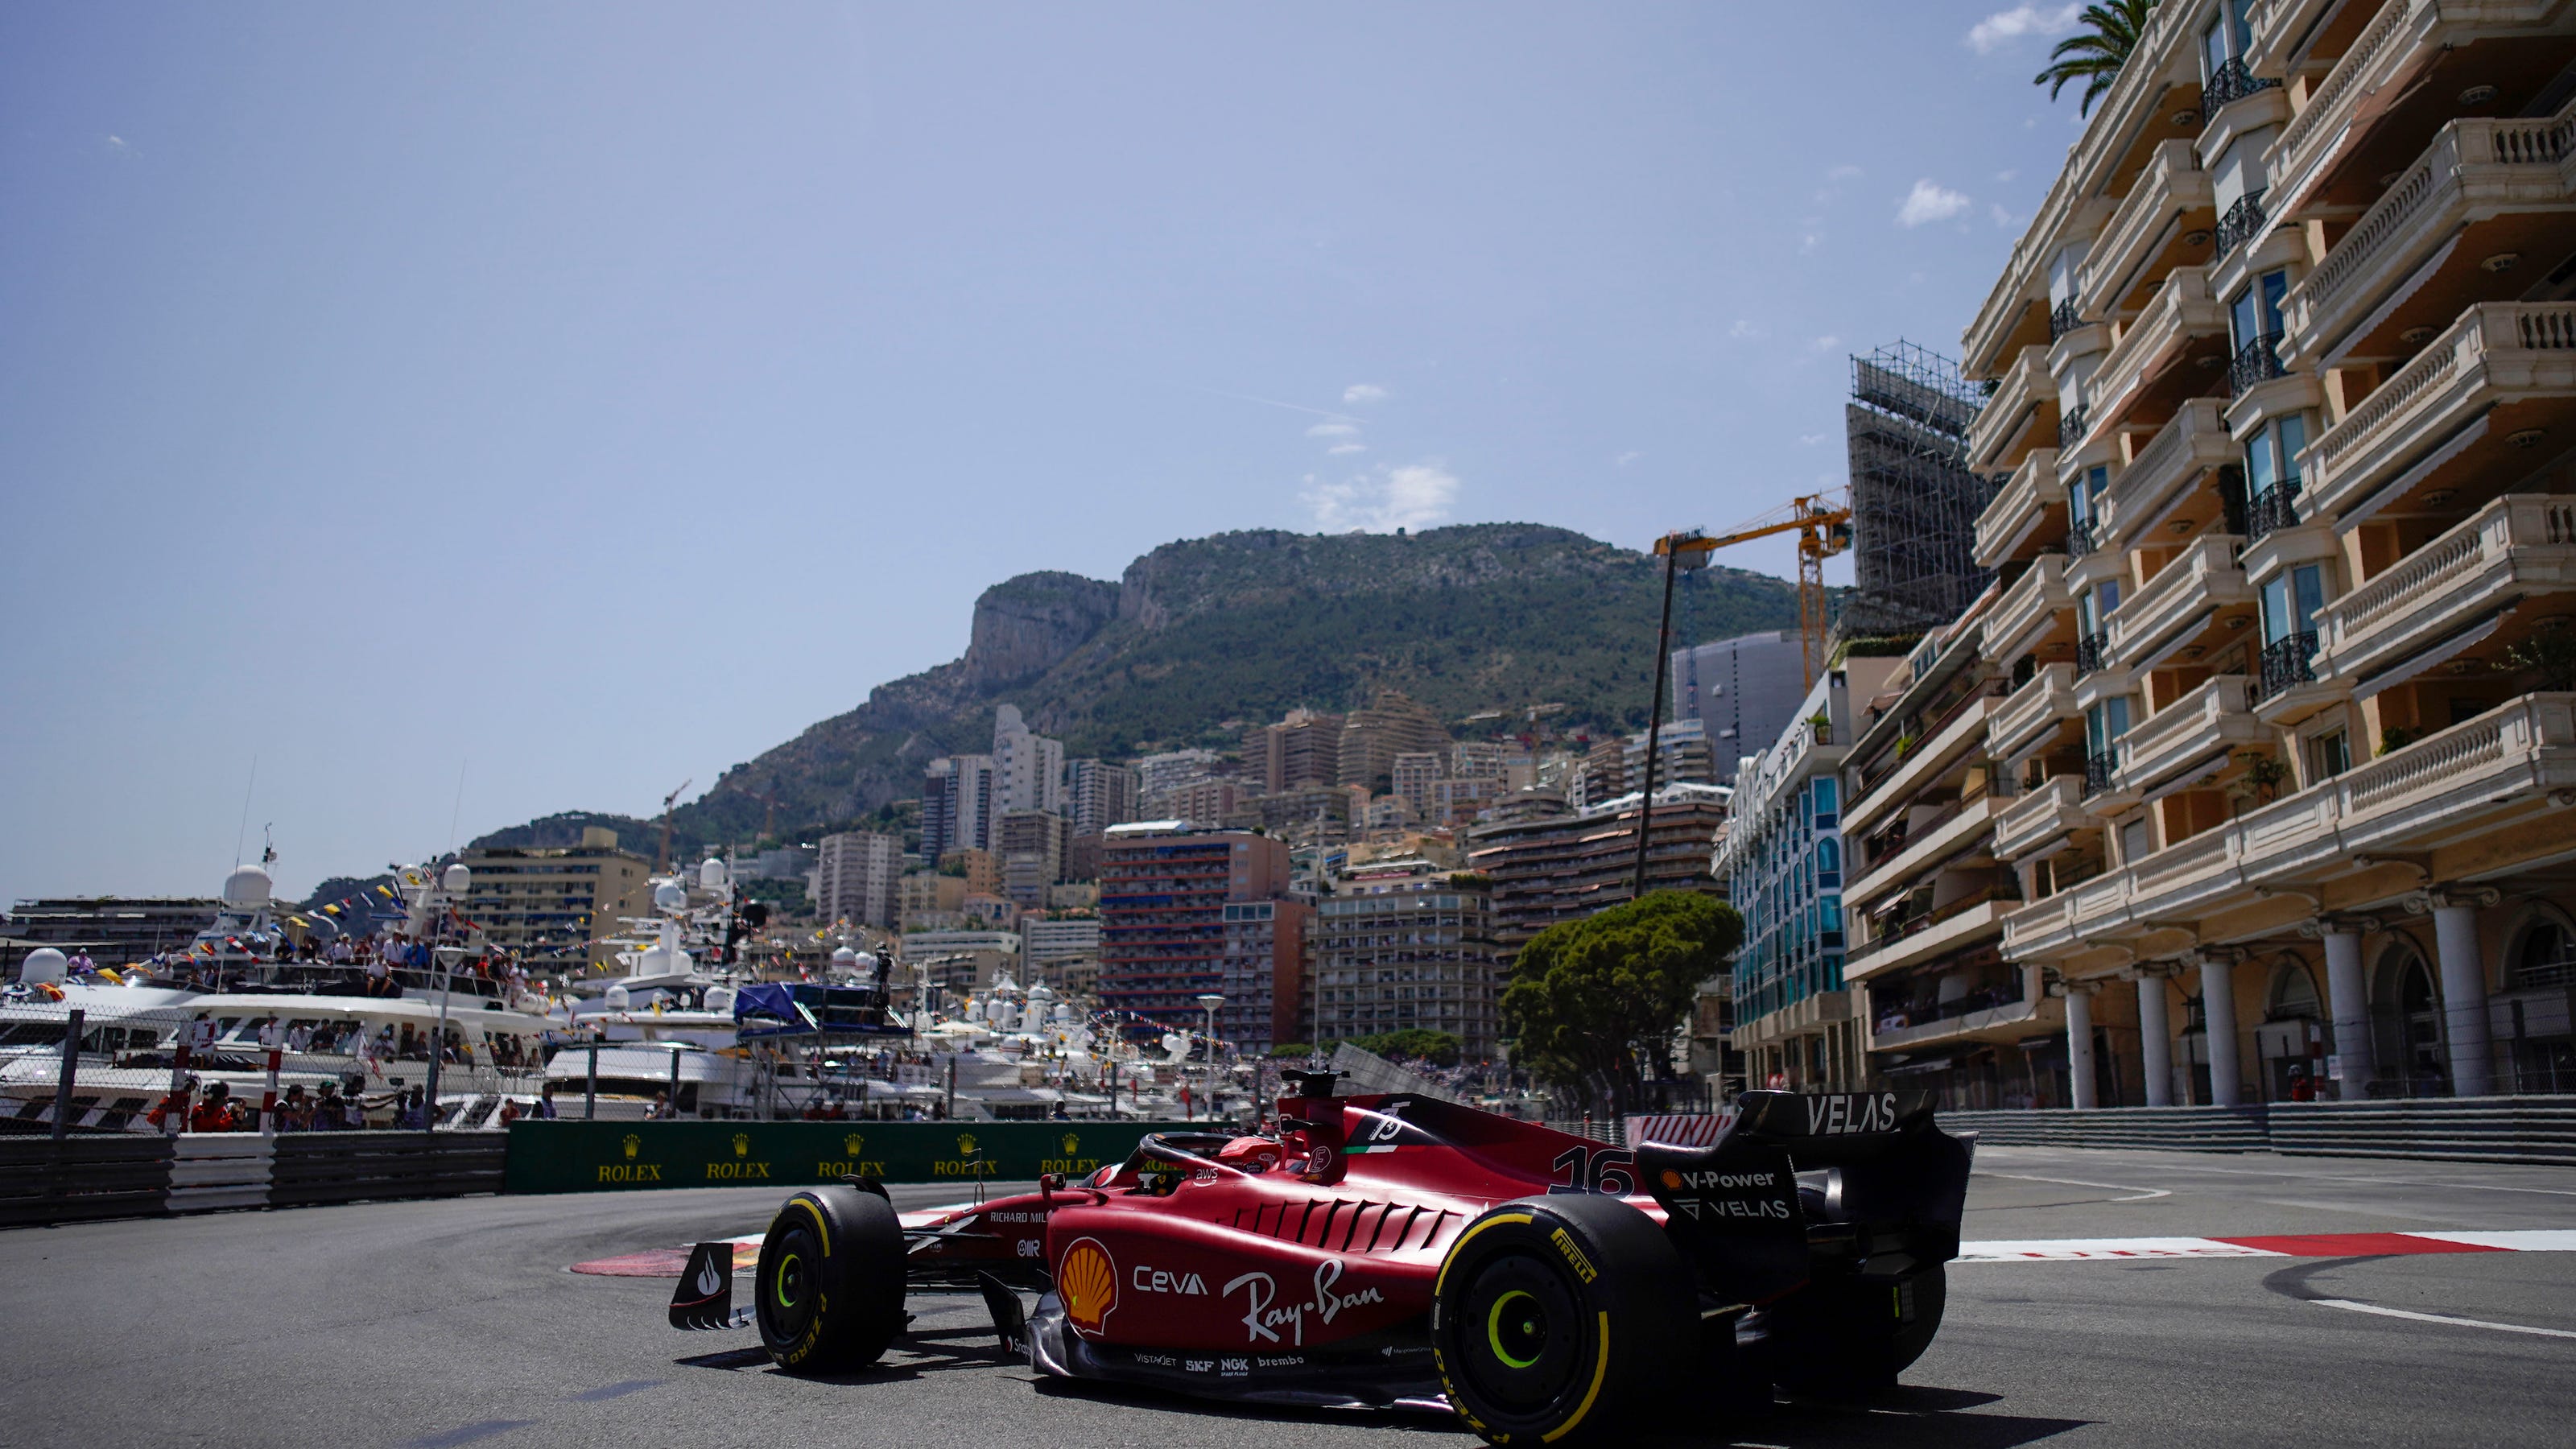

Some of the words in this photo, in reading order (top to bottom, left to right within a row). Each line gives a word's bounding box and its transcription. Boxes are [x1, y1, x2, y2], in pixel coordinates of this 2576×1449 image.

[1806, 1092, 1897, 1136] VELAS
[598, 1165, 662, 1183] ROLEX
[706, 1162, 770, 1179] ROLEX
[817, 1162, 886, 1178] ROLEX
[934, 1160, 997, 1175] ROLEX
[1040, 1159, 1100, 1174] ROLEX
[1196, 1167, 1219, 1180] aws
[1547, 1146, 1634, 1199] 16
[1682, 1171, 1774, 1190] V-Power
[990, 1212, 1028, 1223] RICHARD
[1030, 1212, 1047, 1223] MIL
[1708, 1199, 1790, 1220] VELAS
[1550, 1227, 1598, 1285] PIRELLI
[1014, 1338, 1032, 1358] Snap
[1186, 1359, 1215, 1372] SKF
[1220, 1358, 1249, 1371] NGK
[1257, 1356, 1305, 1368] brembo
